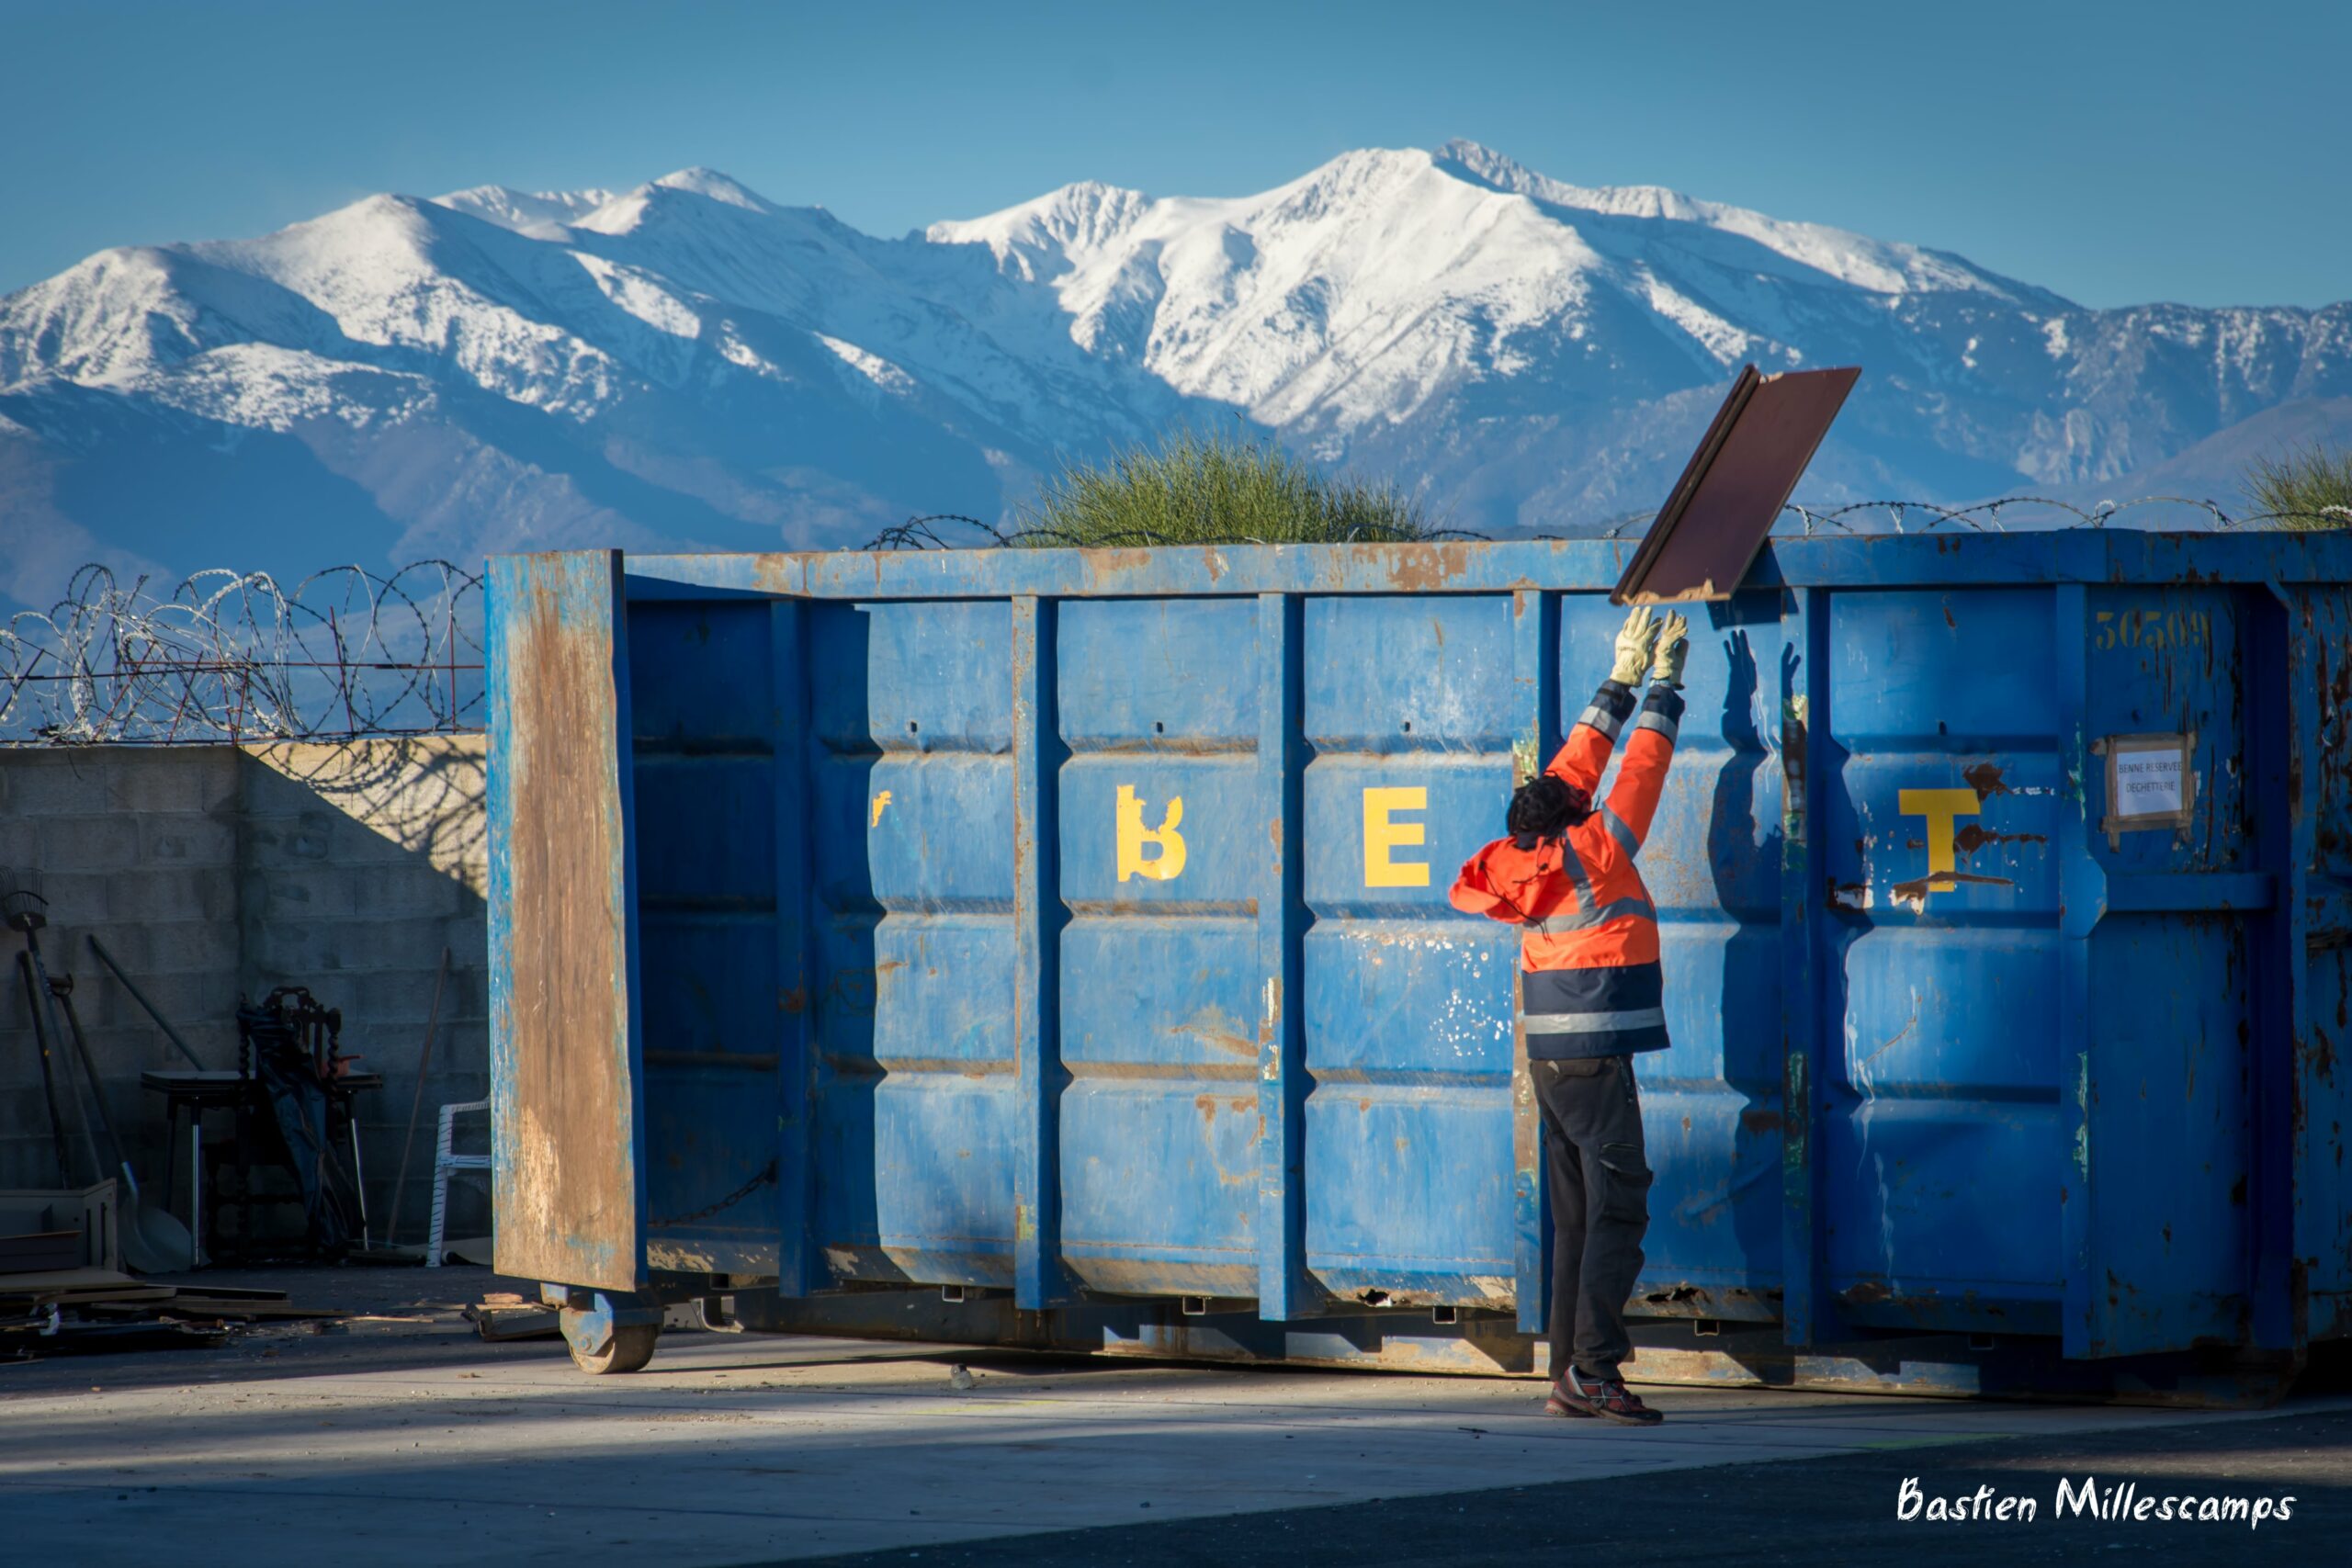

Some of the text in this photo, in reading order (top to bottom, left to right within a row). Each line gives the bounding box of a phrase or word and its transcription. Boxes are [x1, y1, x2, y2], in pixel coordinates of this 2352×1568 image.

[2118, 761, 2183, 773] BENNE RESERVEE
[2126, 781, 2176, 793] DECHETTERIE
[1363, 786, 1430, 887] E
[1898, 788, 1981, 893] T
